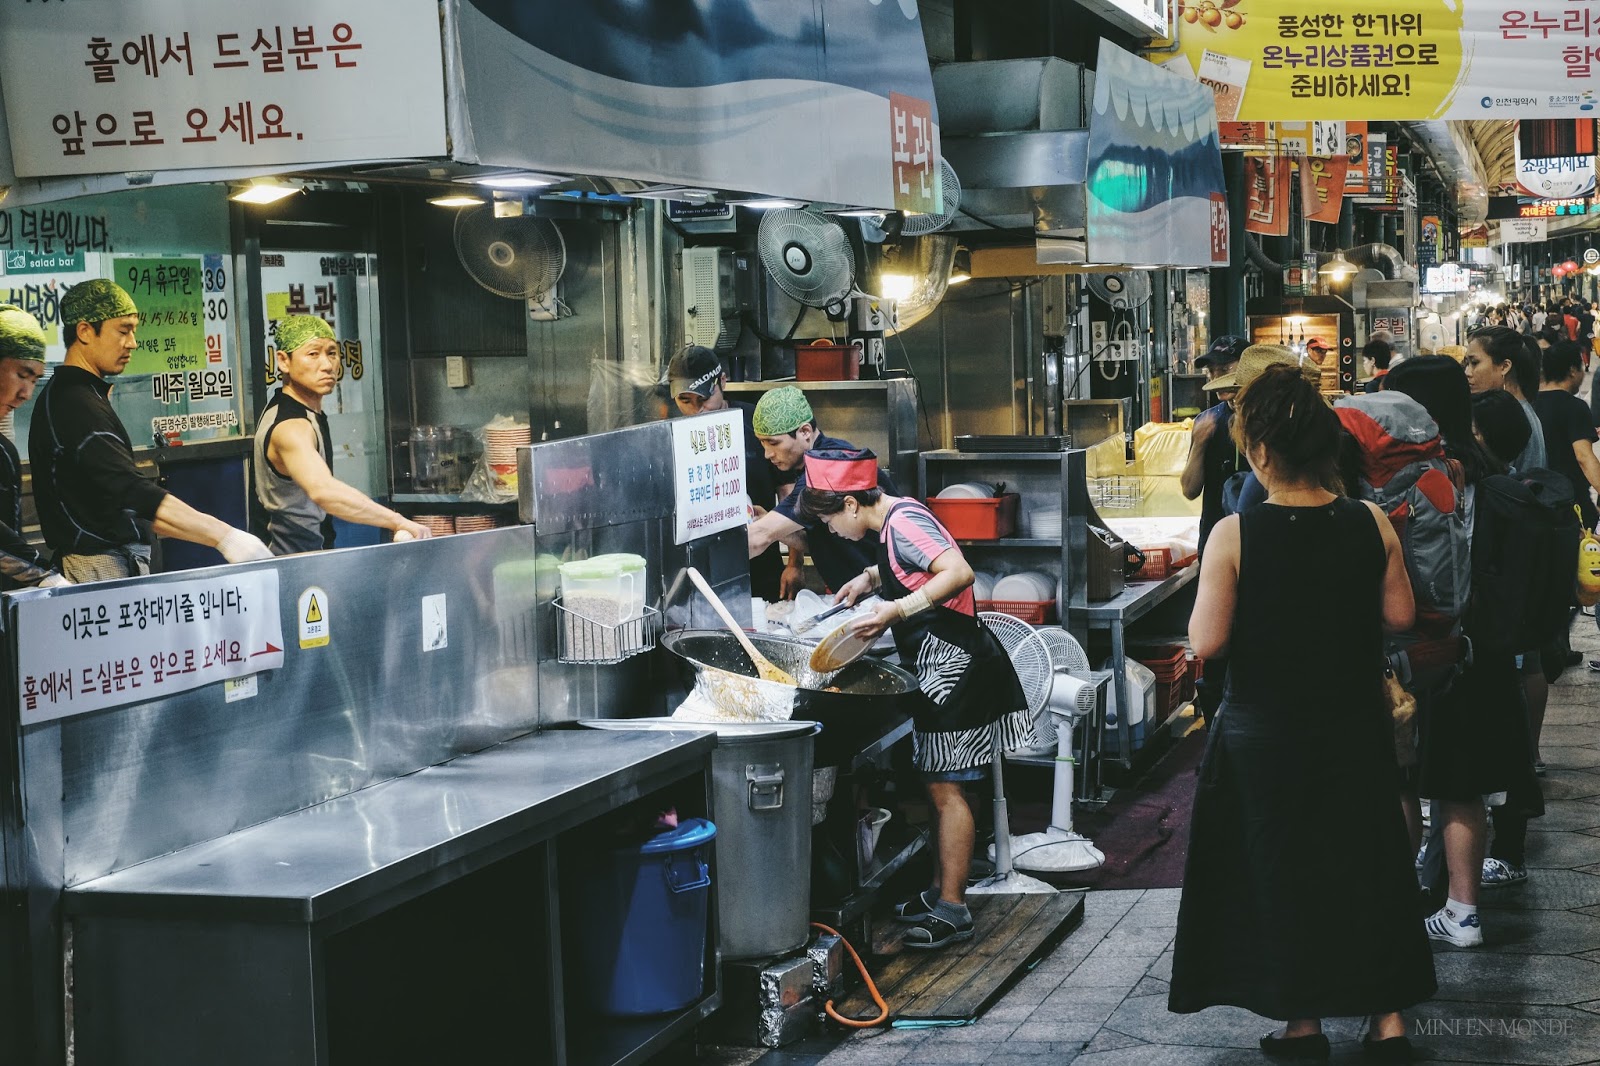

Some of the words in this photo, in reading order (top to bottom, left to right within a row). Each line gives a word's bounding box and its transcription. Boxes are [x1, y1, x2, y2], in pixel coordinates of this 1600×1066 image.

[1278, 14, 1345, 38] 풍성한
[1352, 13, 1422, 37] 한가위
[1499, 8, 1600, 39] 온누리
[84, 31, 195, 84] 홀에서
[213, 23, 363, 74] 드실분은
[1263, 43, 1440, 69] 온누리상품권으로
[1562, 46, 1600, 78] 할
[1291, 73, 1411, 98] 준비하세요!
[1495, 97, 1538, 107] 인천광역시
[52, 111, 165, 157] 앞으로
[182, 101, 304, 145] 오세요.
[893, 106, 932, 200] 본관
[20, 208, 114, 256] 덕분입니다.
[30, 257, 56, 269] salad
[58, 254, 76, 268] bar
[156, 264, 192, 297] 휴무일
[153, 372, 185, 403] 매주
[187, 369, 234, 401] 월요일
[721, 455, 740, 475] 16,000
[690, 484, 712, 504] 후라이드
[722, 479, 741, 498] 12,000
[62, 603, 111, 640] 이곳은
[117, 595, 195, 630] 포장대기줄
[199, 586, 248, 620] 입니다.
[22, 663, 75, 711] 홀에서
[81, 656, 144, 696] 드실분은
[150, 647, 197, 684] 앞으로
[202, 639, 248, 670] 오세요.
